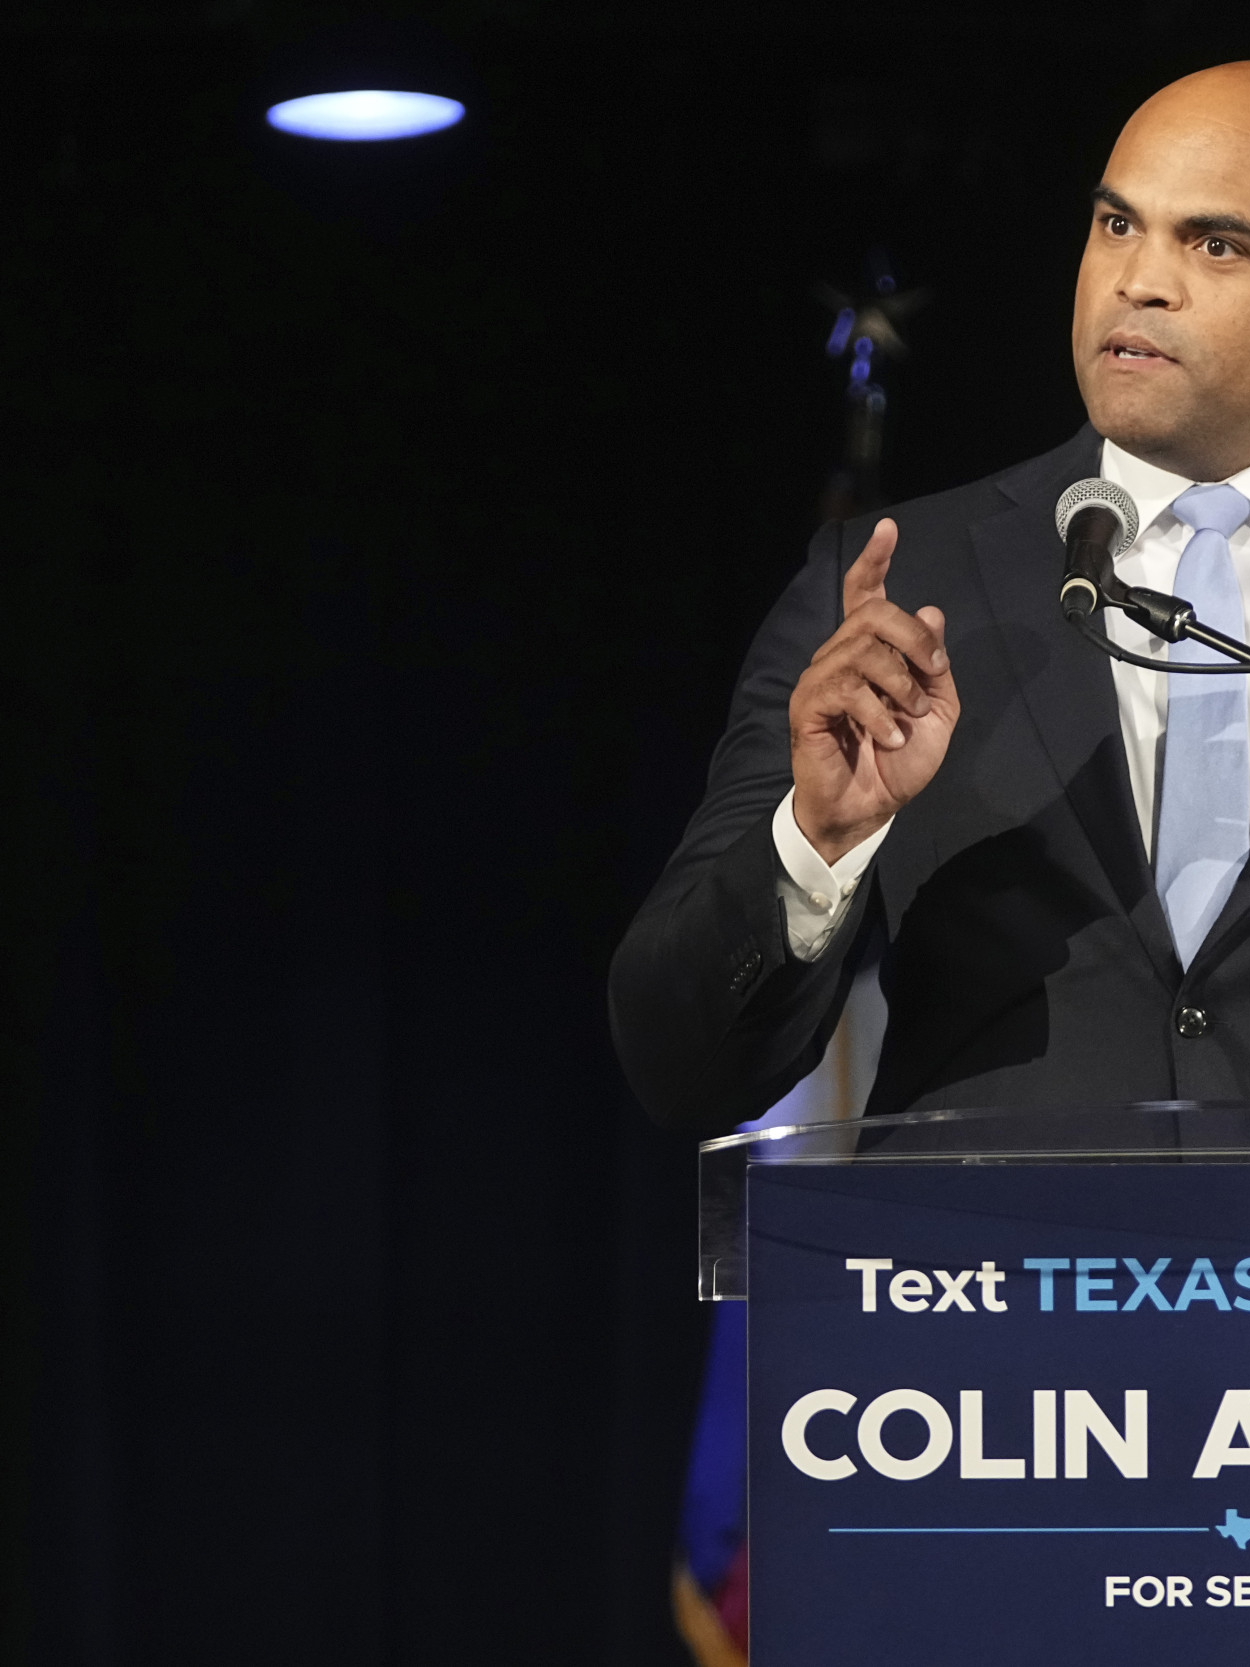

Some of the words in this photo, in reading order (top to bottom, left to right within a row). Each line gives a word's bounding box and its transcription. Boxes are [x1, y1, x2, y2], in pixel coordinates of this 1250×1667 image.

[846, 1258, 1008, 1313] Text
[781, 1388, 1149, 1481] COLIN
[1105, 1575, 1193, 1608] FOR
